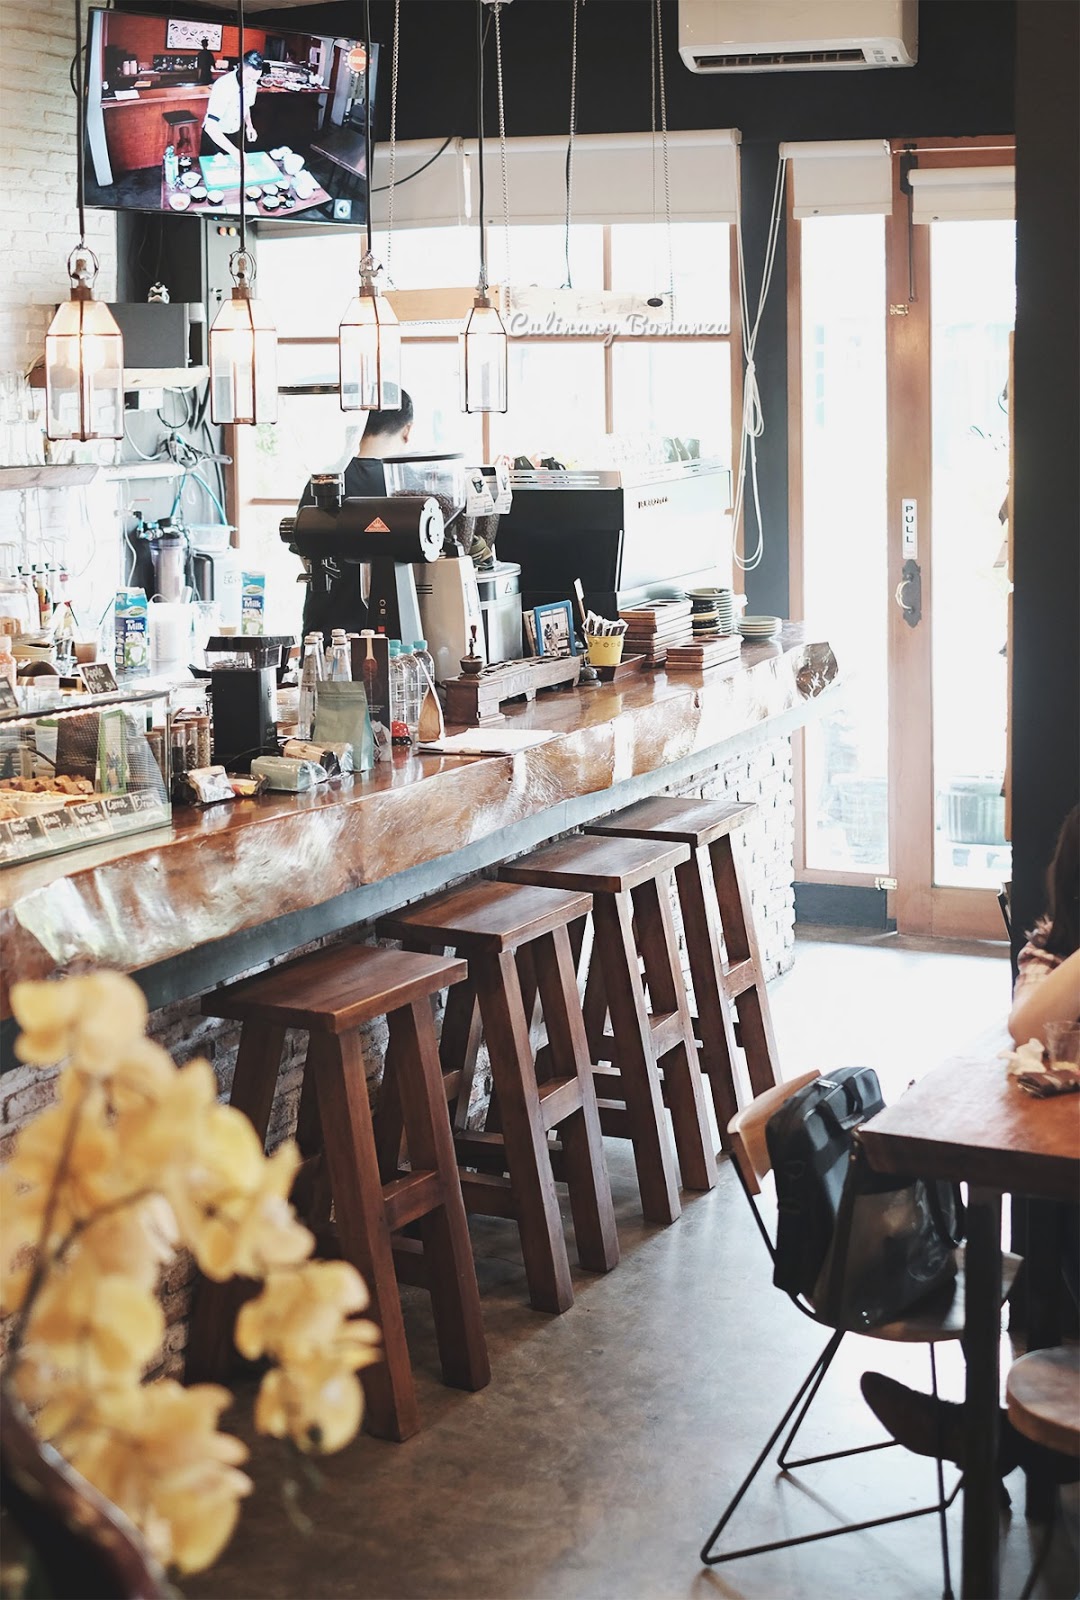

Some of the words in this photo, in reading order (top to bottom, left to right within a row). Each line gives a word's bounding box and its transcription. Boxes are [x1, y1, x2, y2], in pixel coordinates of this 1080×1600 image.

[510, 311, 620, 347] Culinary
[626, 313, 731, 336] Bonanza
[905, 505, 914, 543] PULL
[244, 600, 262, 608] Milk
[127, 622, 145, 631] Milk
